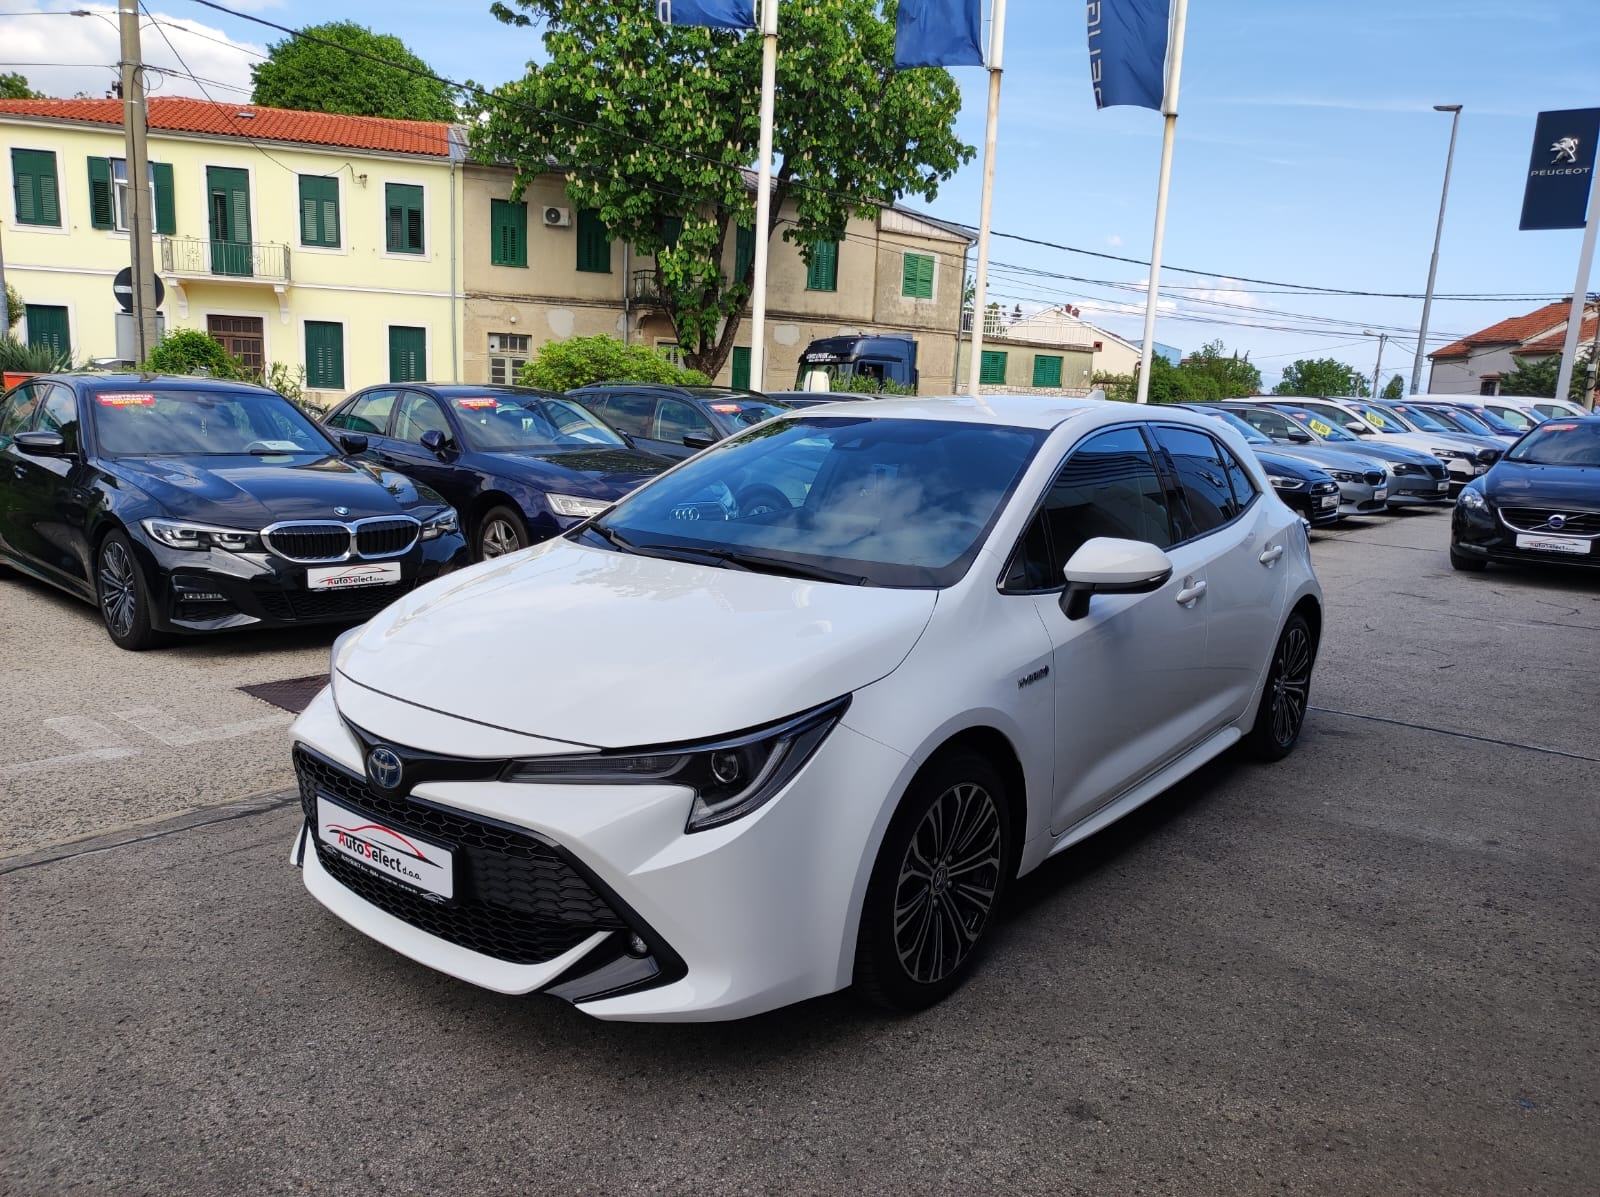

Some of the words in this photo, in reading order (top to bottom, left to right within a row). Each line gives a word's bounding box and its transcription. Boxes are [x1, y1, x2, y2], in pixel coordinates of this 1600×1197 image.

[1531, 167, 1590, 176] PEUGEOT
[327, 576, 373, 585] AutoSelect
[338, 831, 402, 873] AutoSelect
[402, 867, 422, 881] d.o.o.
